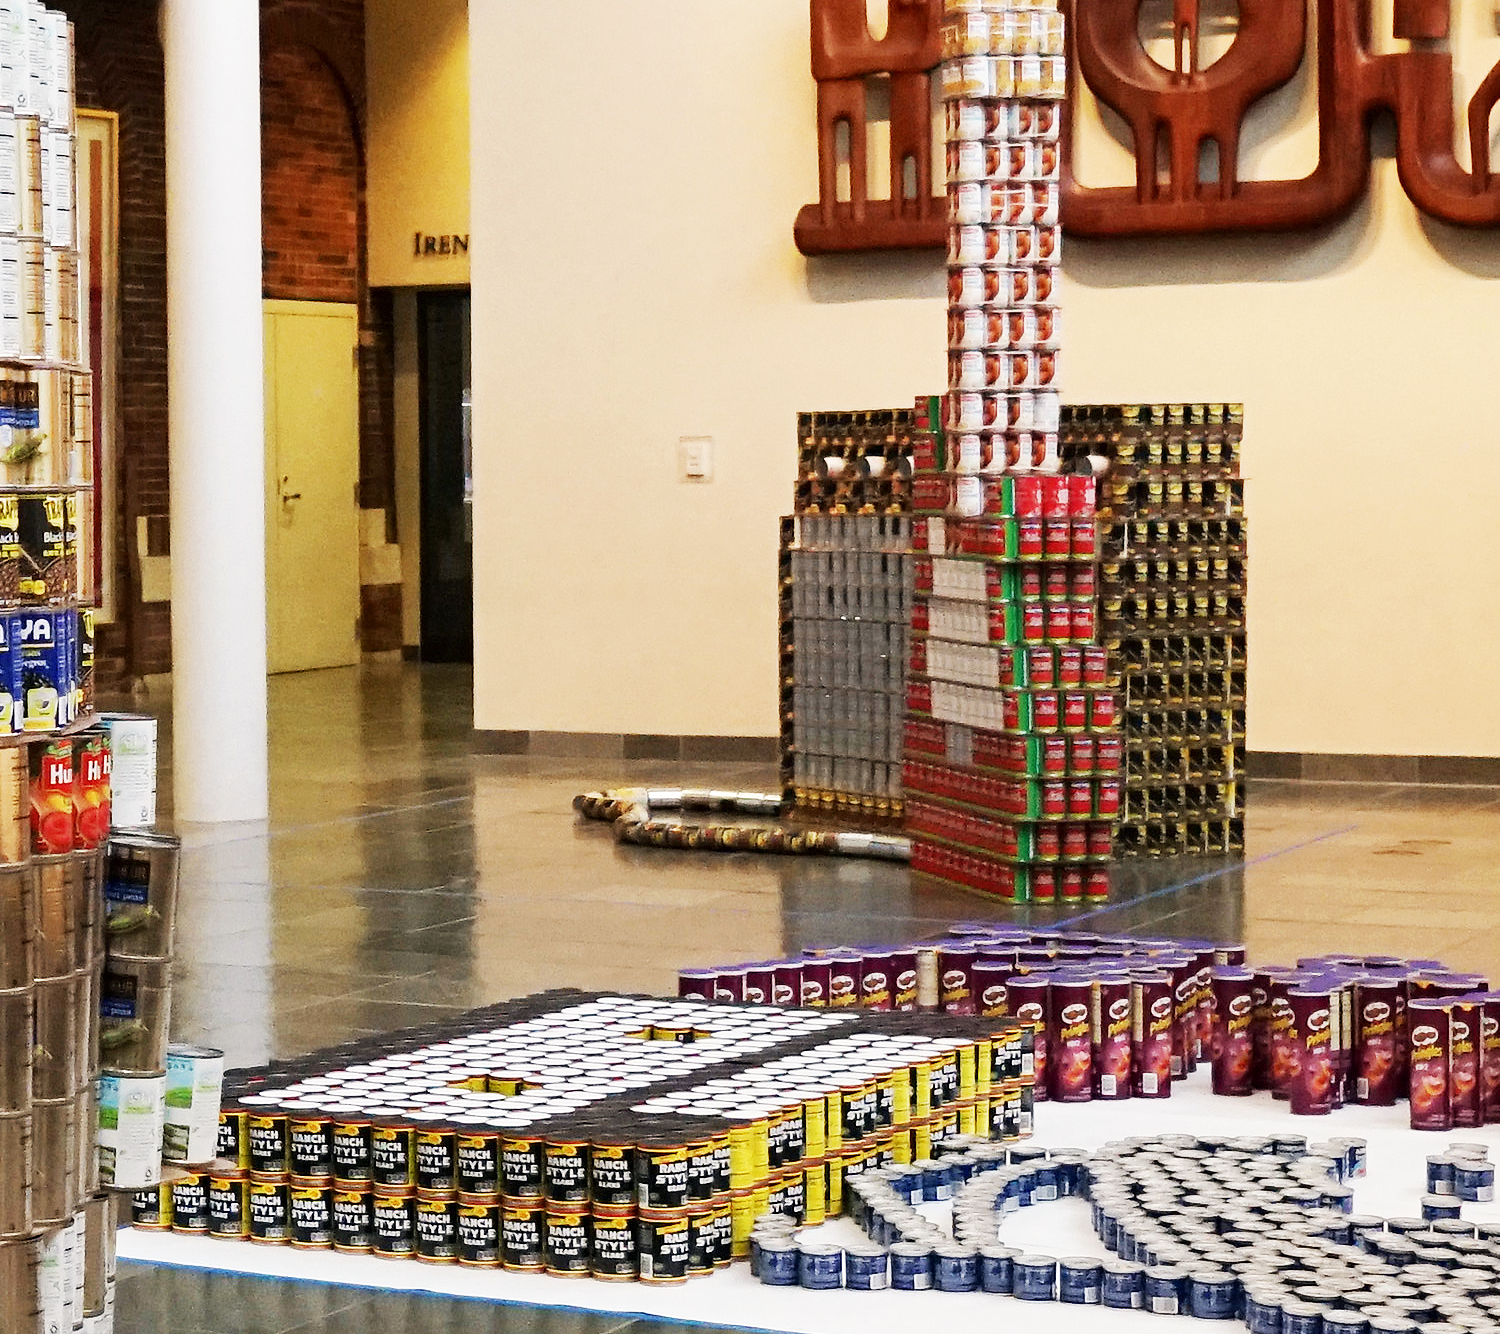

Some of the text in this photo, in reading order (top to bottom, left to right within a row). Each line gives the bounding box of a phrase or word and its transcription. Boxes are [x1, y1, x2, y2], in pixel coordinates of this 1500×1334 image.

[414, 231, 470, 256] IREN
[292, 1133, 326, 1143] RANCH
[291, 1144, 328, 1154] STYLE
[459, 1149, 491, 1160] RANCH
[458, 1160, 494, 1170] STYLE
[547, 1156, 581, 1167] RANCH
[594, 1159, 628, 1170] RANCH
[547, 1167, 585, 1178] STYLE
[593, 1170, 631, 1181] STYLE
[292, 1199, 326, 1210] RANCH
[291, 1209, 328, 1220] STYLE
[375, 1209, 408, 1219] RANCH
[374, 1219, 411, 1230] STYLE
[460, 1217, 493, 1228] RANCH
[459, 1227, 496, 1239] STYLE
[550, 1226, 584, 1237] RANCH
[596, 1230, 631, 1240] RANCH
[548, 1237, 587, 1248] STYLE
[595, 1240, 634, 1251] STYLE
